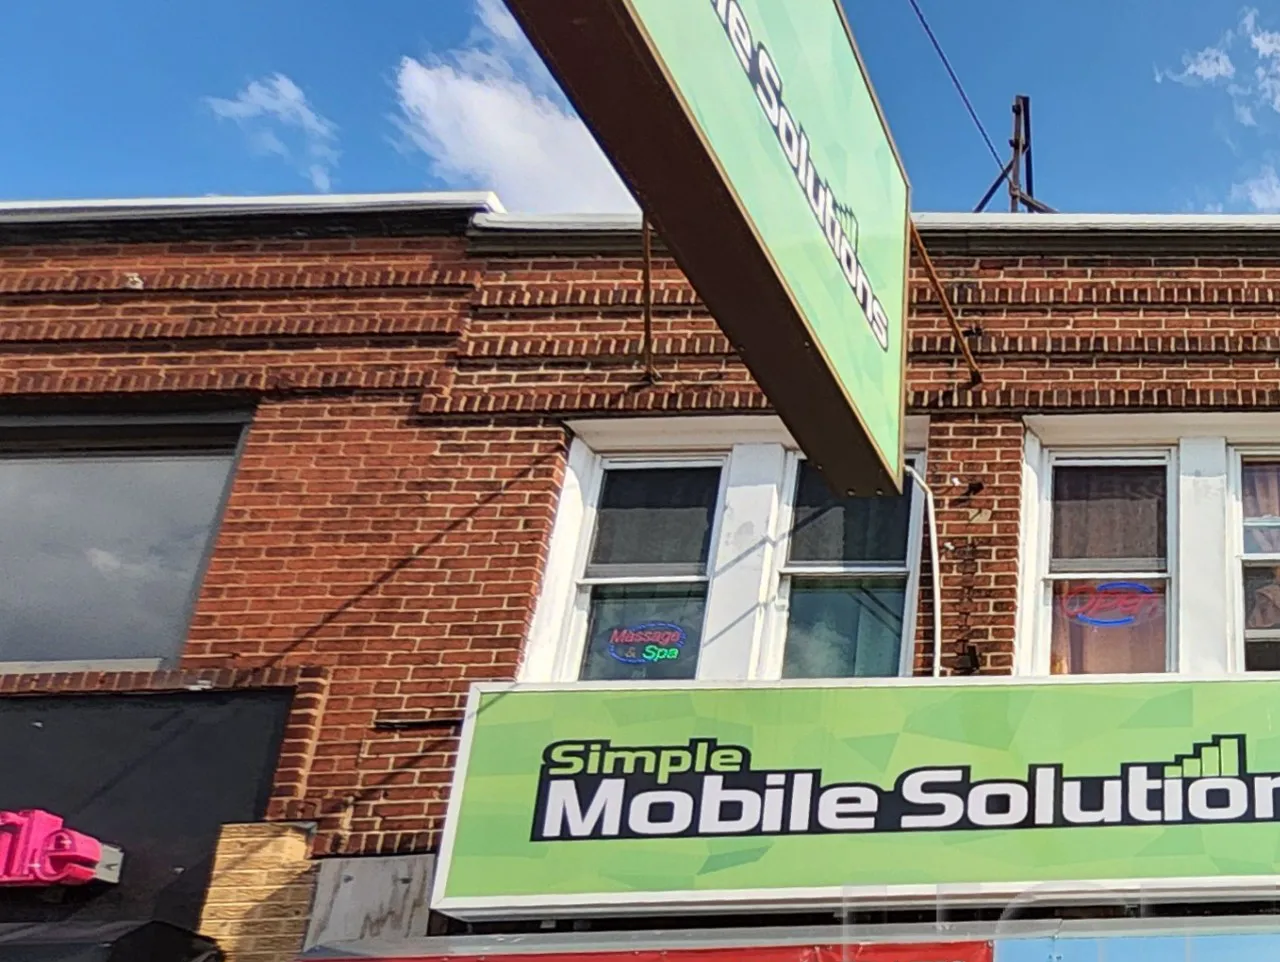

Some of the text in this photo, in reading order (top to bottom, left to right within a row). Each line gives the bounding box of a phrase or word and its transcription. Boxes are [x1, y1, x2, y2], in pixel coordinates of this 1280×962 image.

[756, 42, 888, 352] Solutions
[610, 628, 681, 645] Massage
[642, 645, 680, 661] Spa
[548, 742, 744, 785] Simple
[542, 772, 879, 838] Mobile
